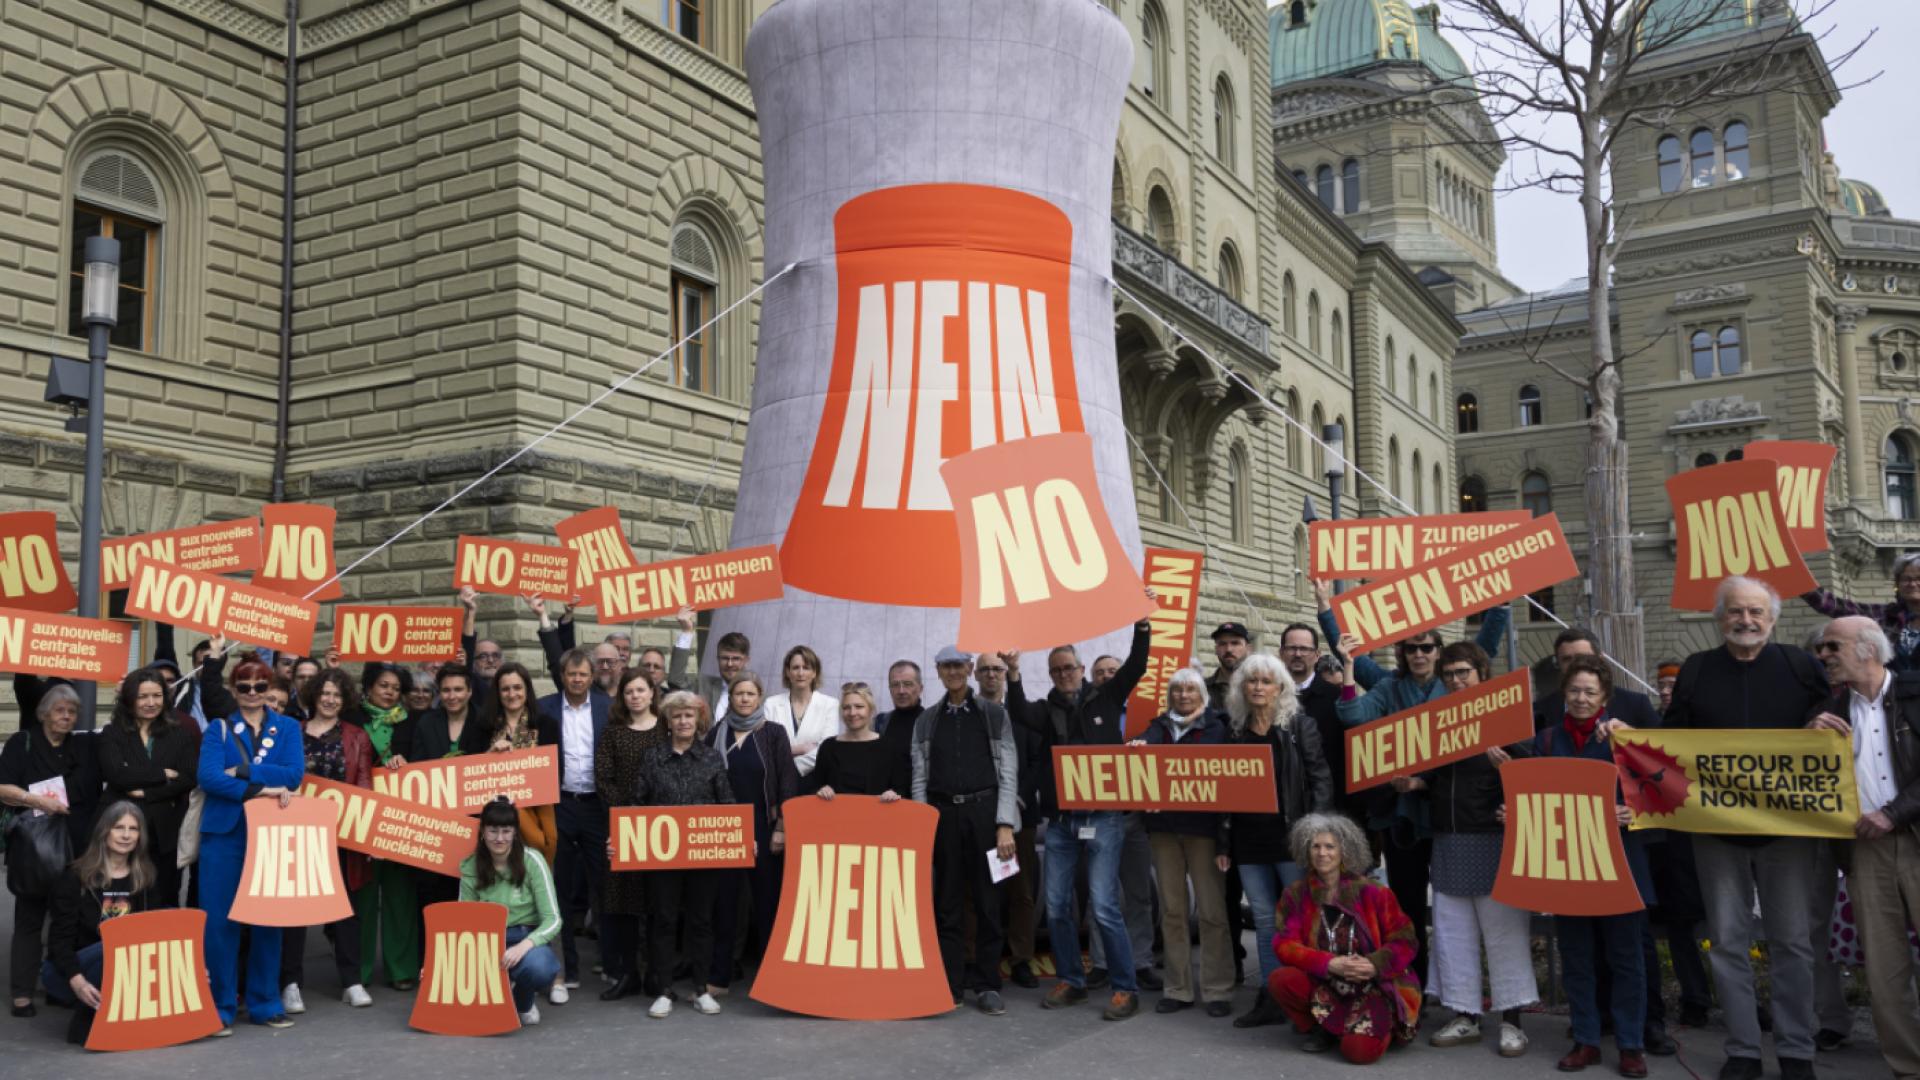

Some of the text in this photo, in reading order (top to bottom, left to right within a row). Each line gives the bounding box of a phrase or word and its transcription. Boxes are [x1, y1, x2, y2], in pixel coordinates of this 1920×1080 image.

[822, 280, 1061, 511] NEIN
[180, 527, 253, 547] aux nouvelles
[971, 478, 1108, 610] NO
[1317, 524, 1413, 573] NEIN
[1421, 527, 1446, 544] zu
[1685, 491, 1791, 580] NON
[103, 537, 175, 584] NON
[180, 544, 233, 559] centrales
[263, 524, 327, 581] NO
[461, 543, 515, 587] NO
[522, 552, 568, 566] a nuove
[568, 525, 631, 589] NEIN
[521, 565, 567, 579] centrali
[601, 556, 773, 617] NEIN zu neuen
[135, 565, 226, 628] NON
[520, 580, 568, 595] nucleari
[694, 580, 735, 603] AKW
[1340, 566, 1454, 645] NEIN
[1447, 559, 1477, 582] zu
[1480, 529, 1556, 564] neuen
[1461, 568, 1513, 607] AKW
[230, 591, 311, 620] aux nouvelles
[1150, 556, 1195, 649] NEIN
[224, 620, 288, 644] nucléaires
[227, 607, 285, 629] centrales
[405, 616, 453, 627] a nuove
[31, 638, 96, 656] centrales
[32, 623, 123, 644] aux nouvelles
[341, 613, 399, 655] NO
[404, 628, 452, 640] centrali
[403, 642, 454, 655] nucleari
[28, 654, 102, 673] nucléaires
[1136, 655, 1160, 700] AKW
[1351, 684, 1523, 784] NEIN zu neuen
[1438, 721, 1480, 756] AKW
[463, 755, 550, 776] aux nouvelles
[1061, 754, 1265, 801] NEIN zu neuen
[1696, 754, 1841, 773] RETOUR DU
[464, 774, 525, 792] centrales
[1169, 780, 1217, 802] AKW
[1698, 771, 1840, 793] NUCLÉAIRE?
[1700, 790, 1842, 812] NON MERCI
[377, 820, 442, 847] centrales
[382, 805, 472, 839] aux nouvelles
[688, 816, 742, 828] a nuove
[688, 829, 742, 844] centrali
[372, 835, 444, 864] nucléaires
[619, 814, 680, 863] NO
[1512, 793, 1618, 882] NEIN
[248, 825, 336, 898] NEIN
[688, 845, 746, 860] nucleari
[783, 843, 924, 970] NEIN
[107, 939, 202, 1024] NEIN
[428, 931, 505, 1006] NON
